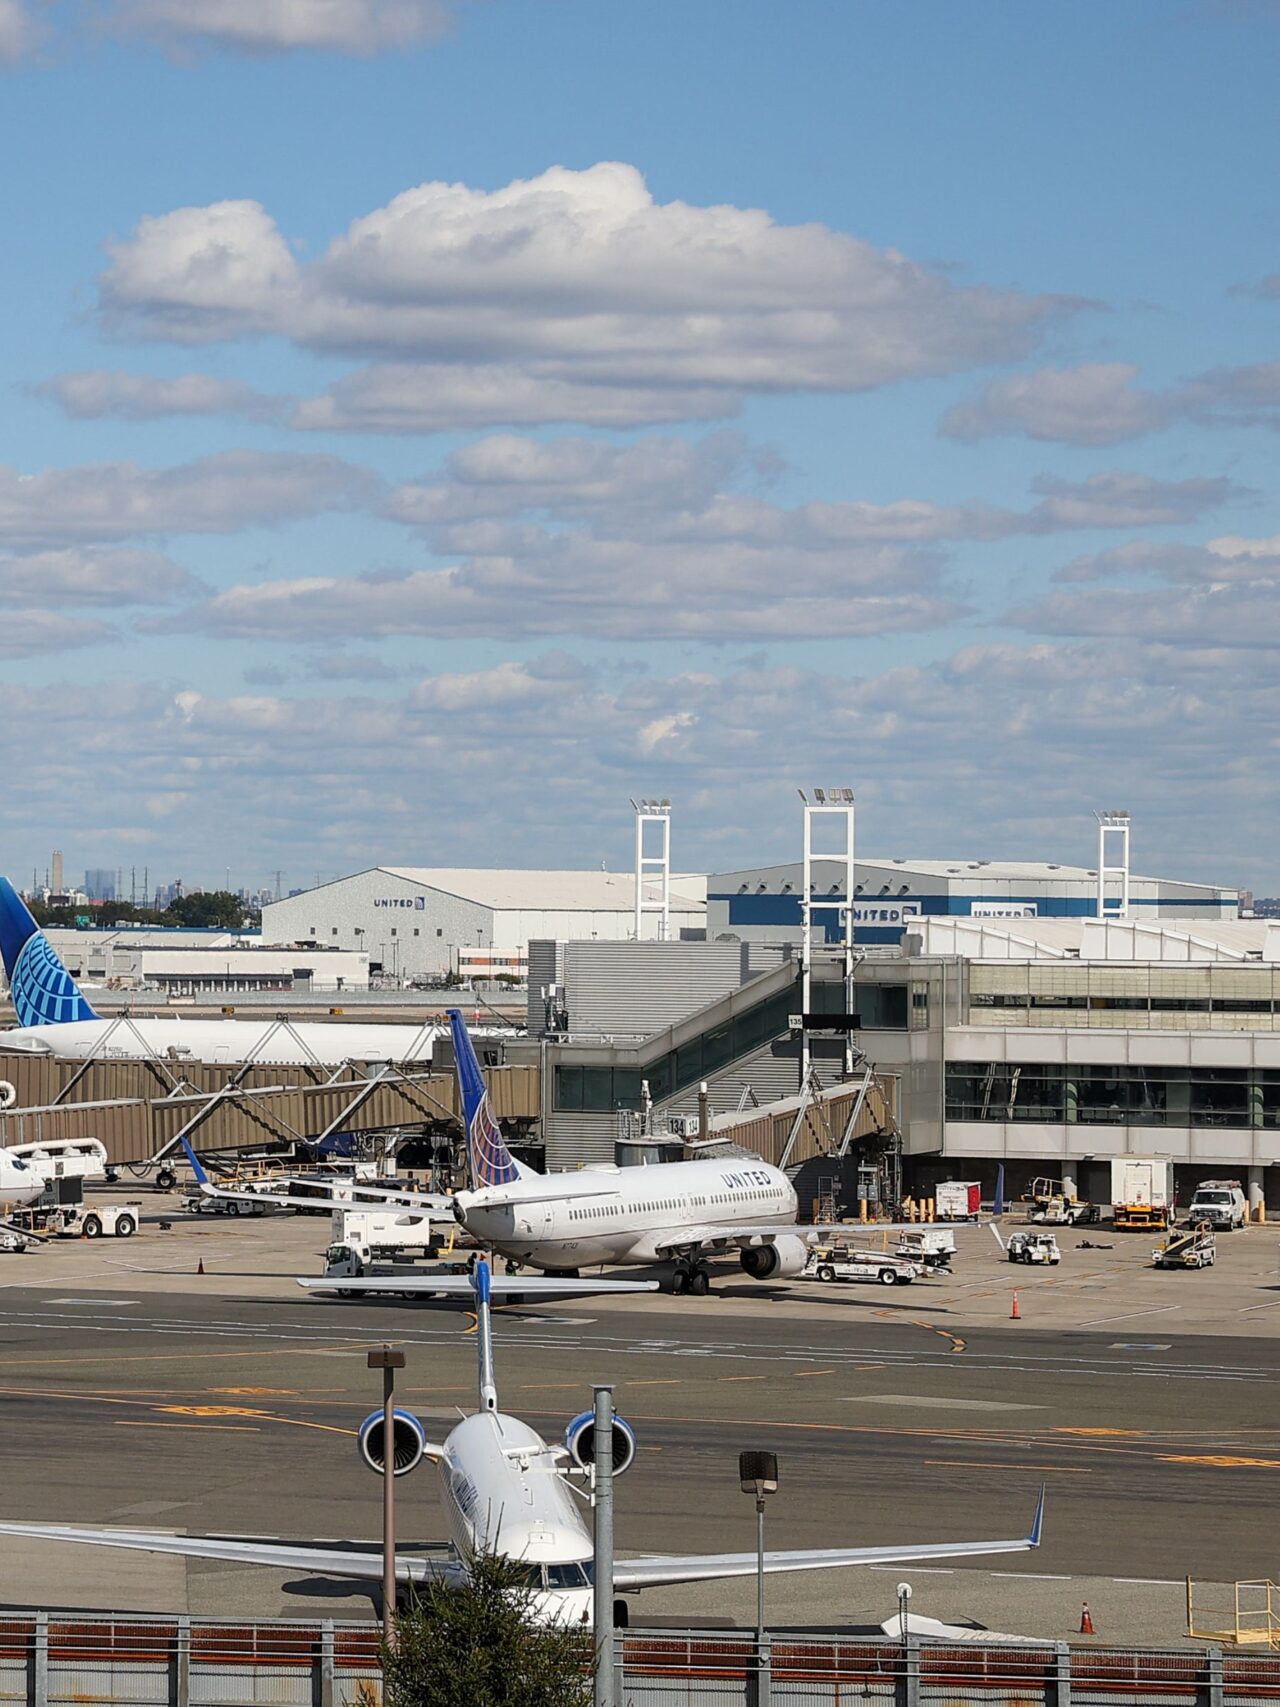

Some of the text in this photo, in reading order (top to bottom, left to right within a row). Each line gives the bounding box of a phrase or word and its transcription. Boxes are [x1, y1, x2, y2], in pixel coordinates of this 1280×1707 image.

[374, 899, 413, 907] UNITED
[670, 1119, 684, 1134] 134
[689, 1119, 698, 1133] 134
[720, 1171, 771, 1188] UNITED
